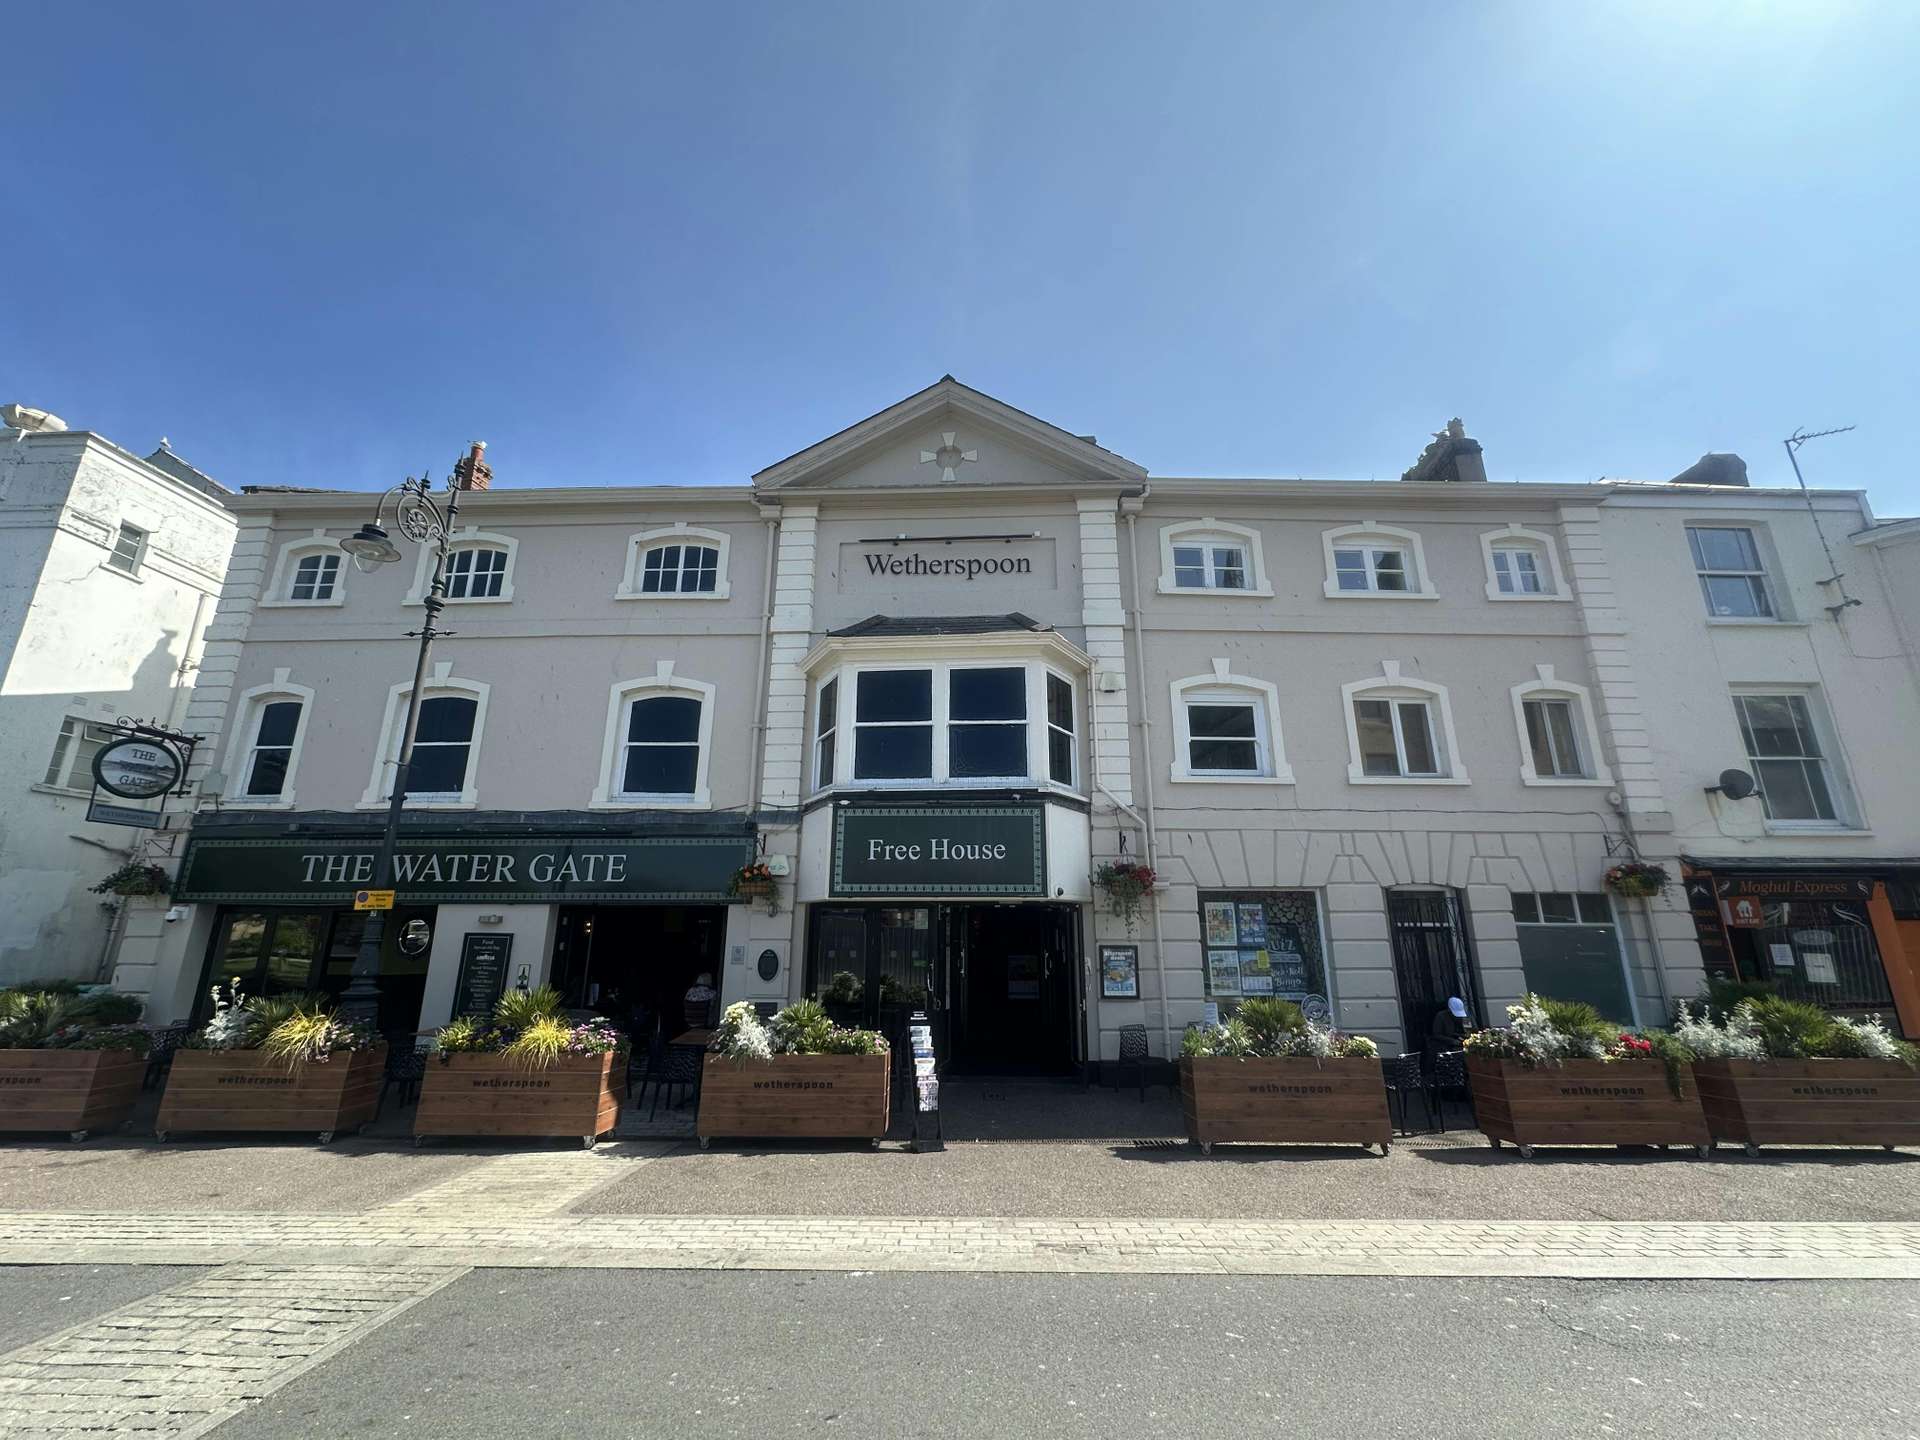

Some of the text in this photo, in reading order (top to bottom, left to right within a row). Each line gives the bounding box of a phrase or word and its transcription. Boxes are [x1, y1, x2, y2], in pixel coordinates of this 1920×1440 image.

[864, 553, 1032, 580] Wetherspoon
[131, 748, 157, 762] THE
[867, 838, 1006, 860] Free House
[302, 853, 627, 882] THE WATER GATE
[1739, 880, 1848, 896] Moghul Express
[472, 1078, 552, 1089] wetherspoon
[753, 1080, 834, 1090] wetherspoon
[1248, 1083, 1333, 1094] wetherspoon
[1560, 1086, 1646, 1096] wetherspoon
